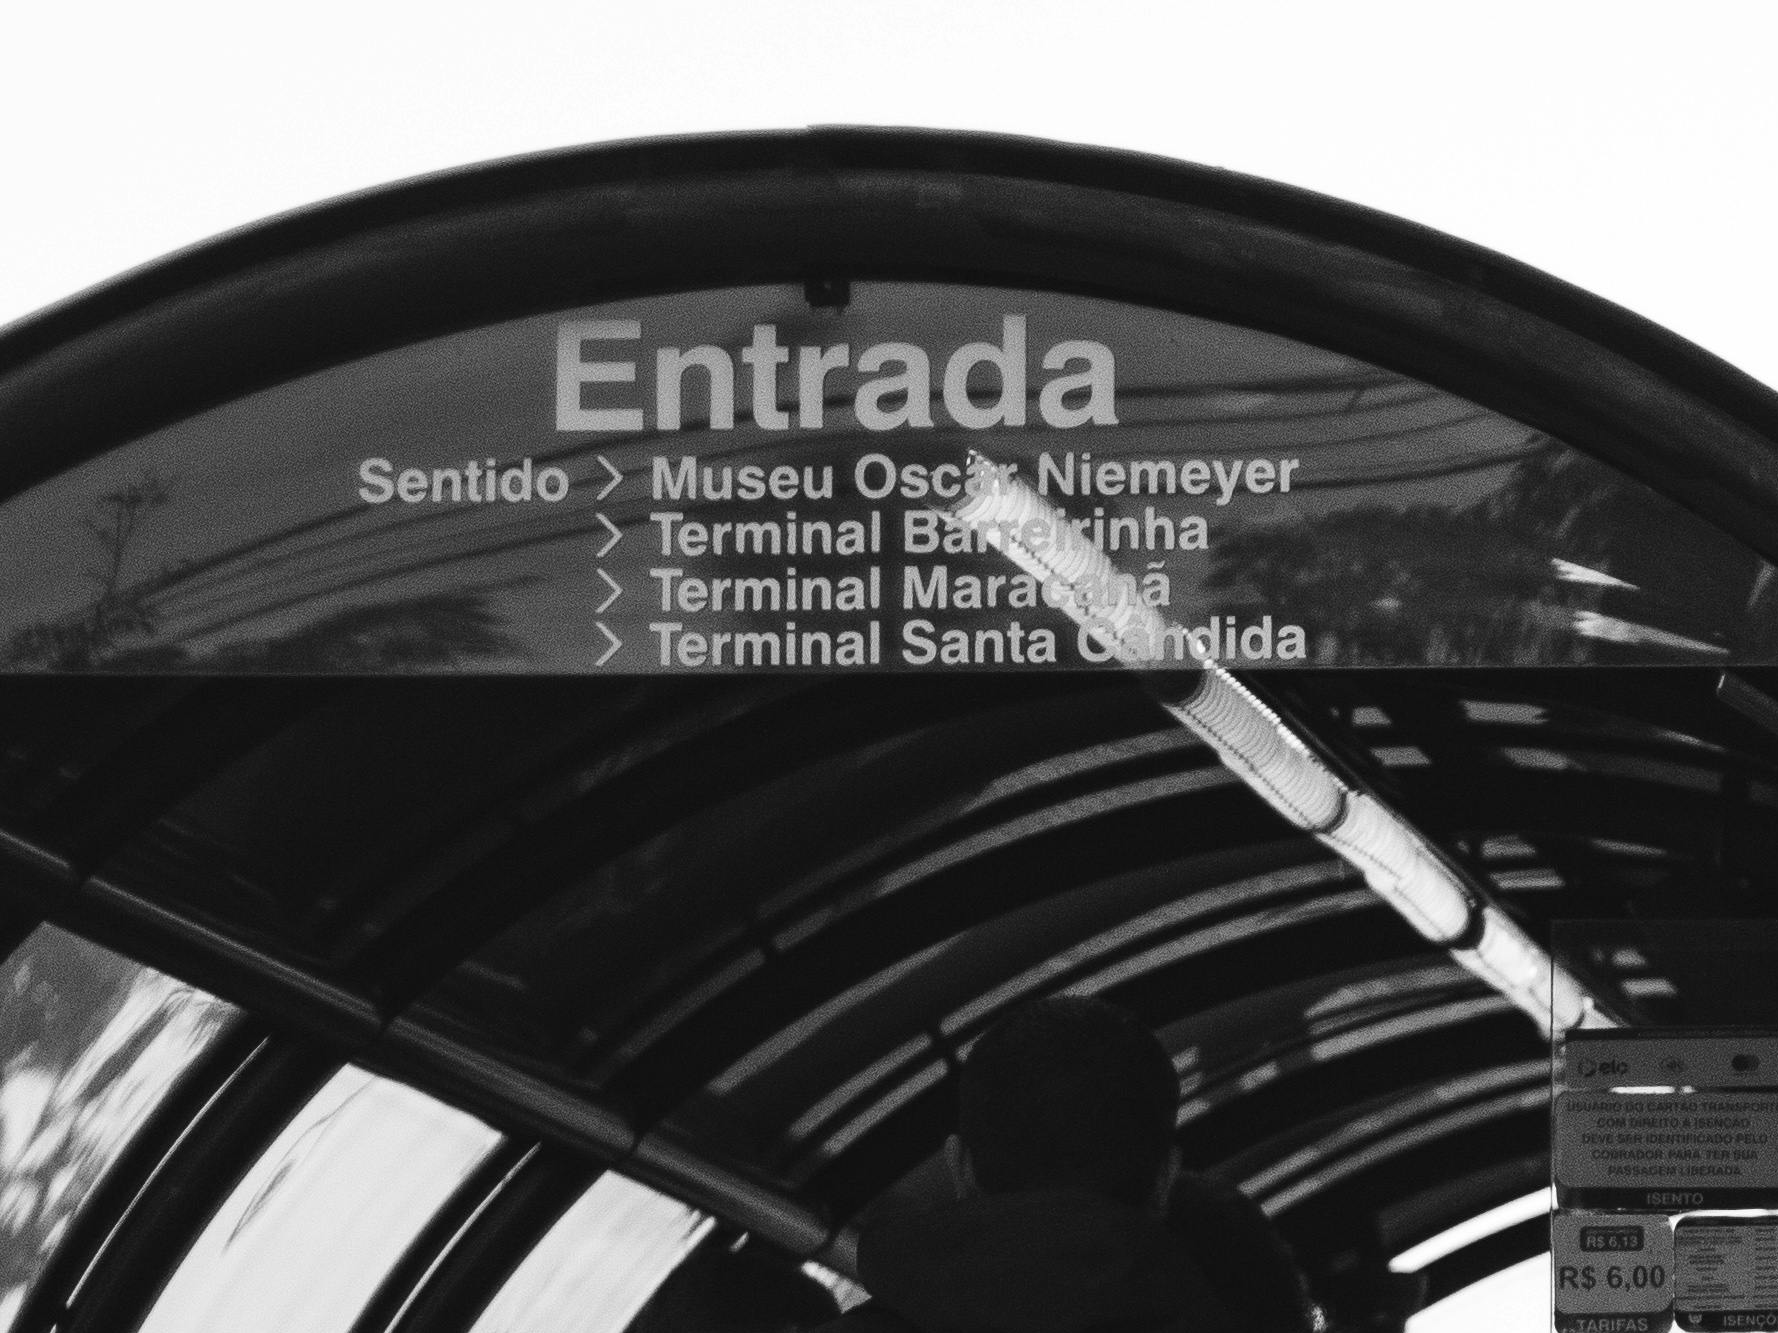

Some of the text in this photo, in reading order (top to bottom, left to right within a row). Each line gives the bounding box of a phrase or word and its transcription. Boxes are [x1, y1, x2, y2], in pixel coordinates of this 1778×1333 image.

[553, 314, 1119, 433] Entrada
[358, 452, 1299, 506] Sentido Museu Oscar Niemeyer
[651, 506, 1208, 556] Terminal Barreirinha
[651, 560, 1171, 612] Terminal Maracanã
[651, 615, 1306, 666] Terminal Santa Cândida
[1648, 1192, 1704, 1205] ISENTO
[1559, 1265, 1665, 1292] R$ 6,00
[1576, 1318, 1649, 1331] TARIFAS
